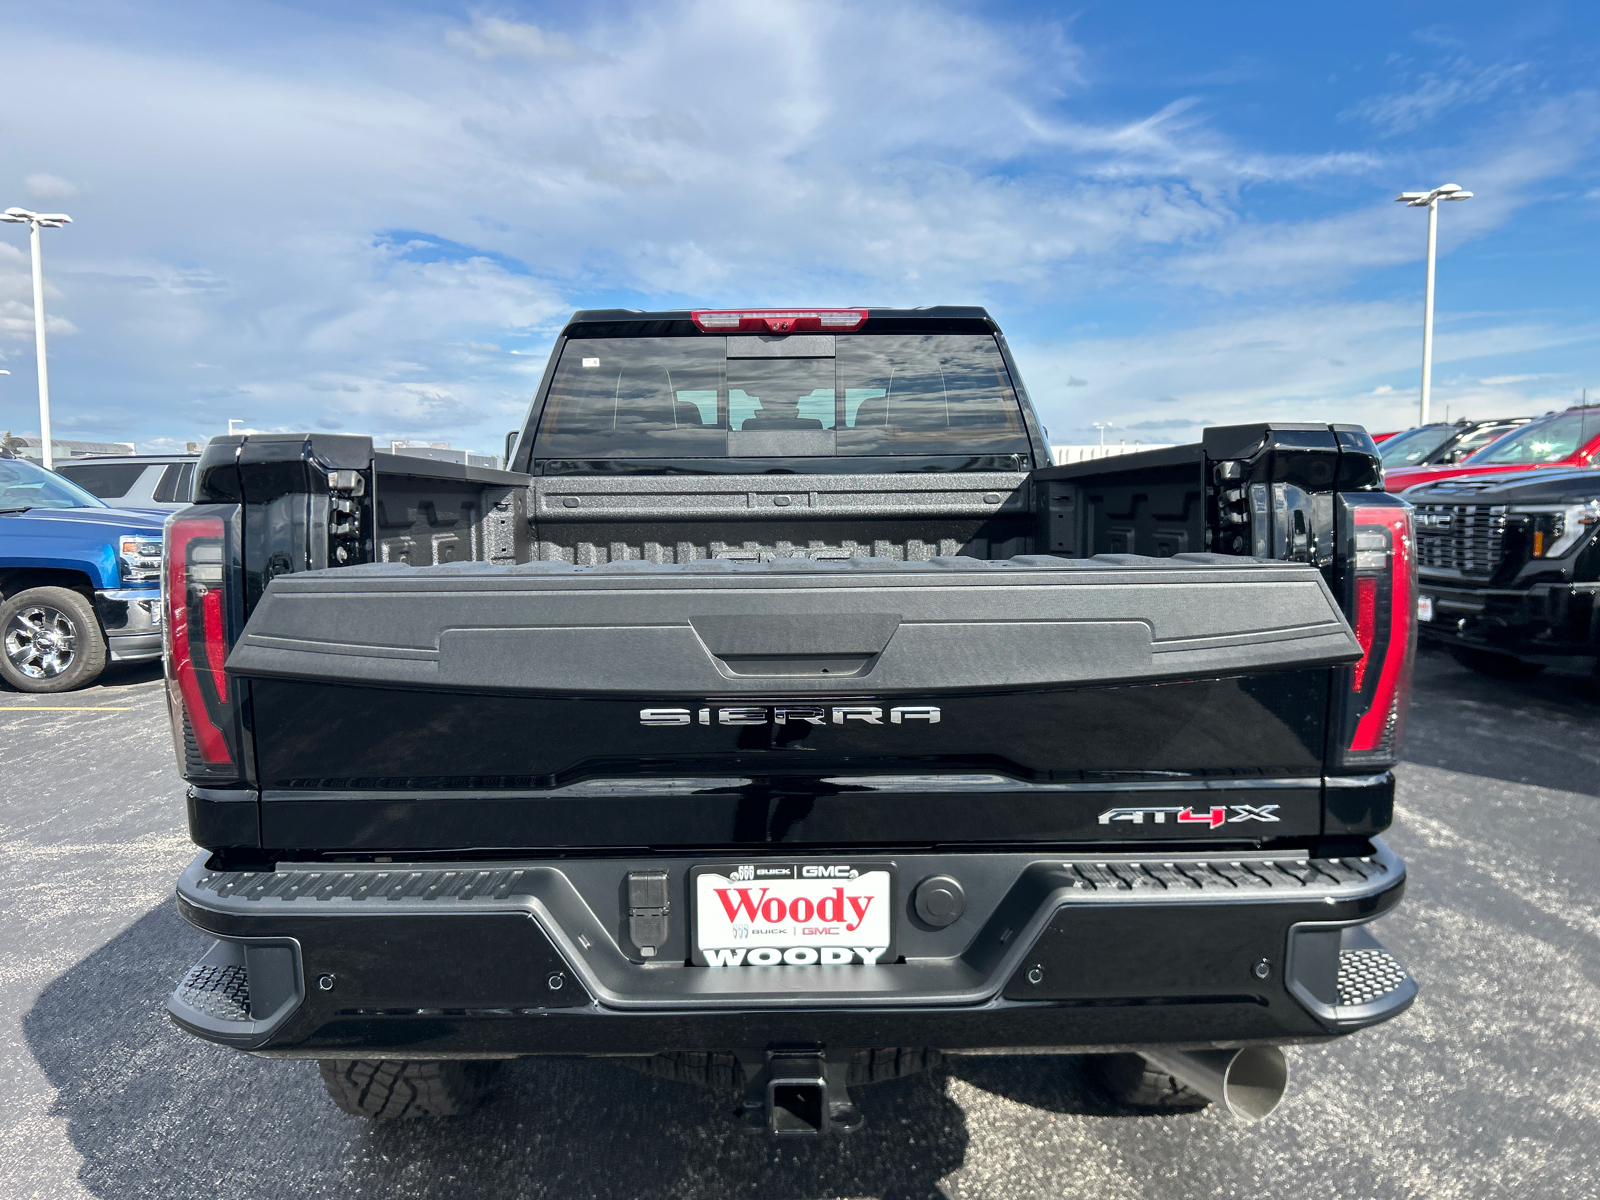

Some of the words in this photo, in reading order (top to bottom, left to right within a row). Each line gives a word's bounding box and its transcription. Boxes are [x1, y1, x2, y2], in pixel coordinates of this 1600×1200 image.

[640, 706, 941, 726] SIERRA
[1098, 804, 1281, 829] AT4X
[756, 868, 791, 876] BUICK
[802, 865, 850, 878] GMC
[713, 887, 875, 932] Woody
[802, 927, 840, 936] GMC
[703, 946, 887, 967] WOODY
